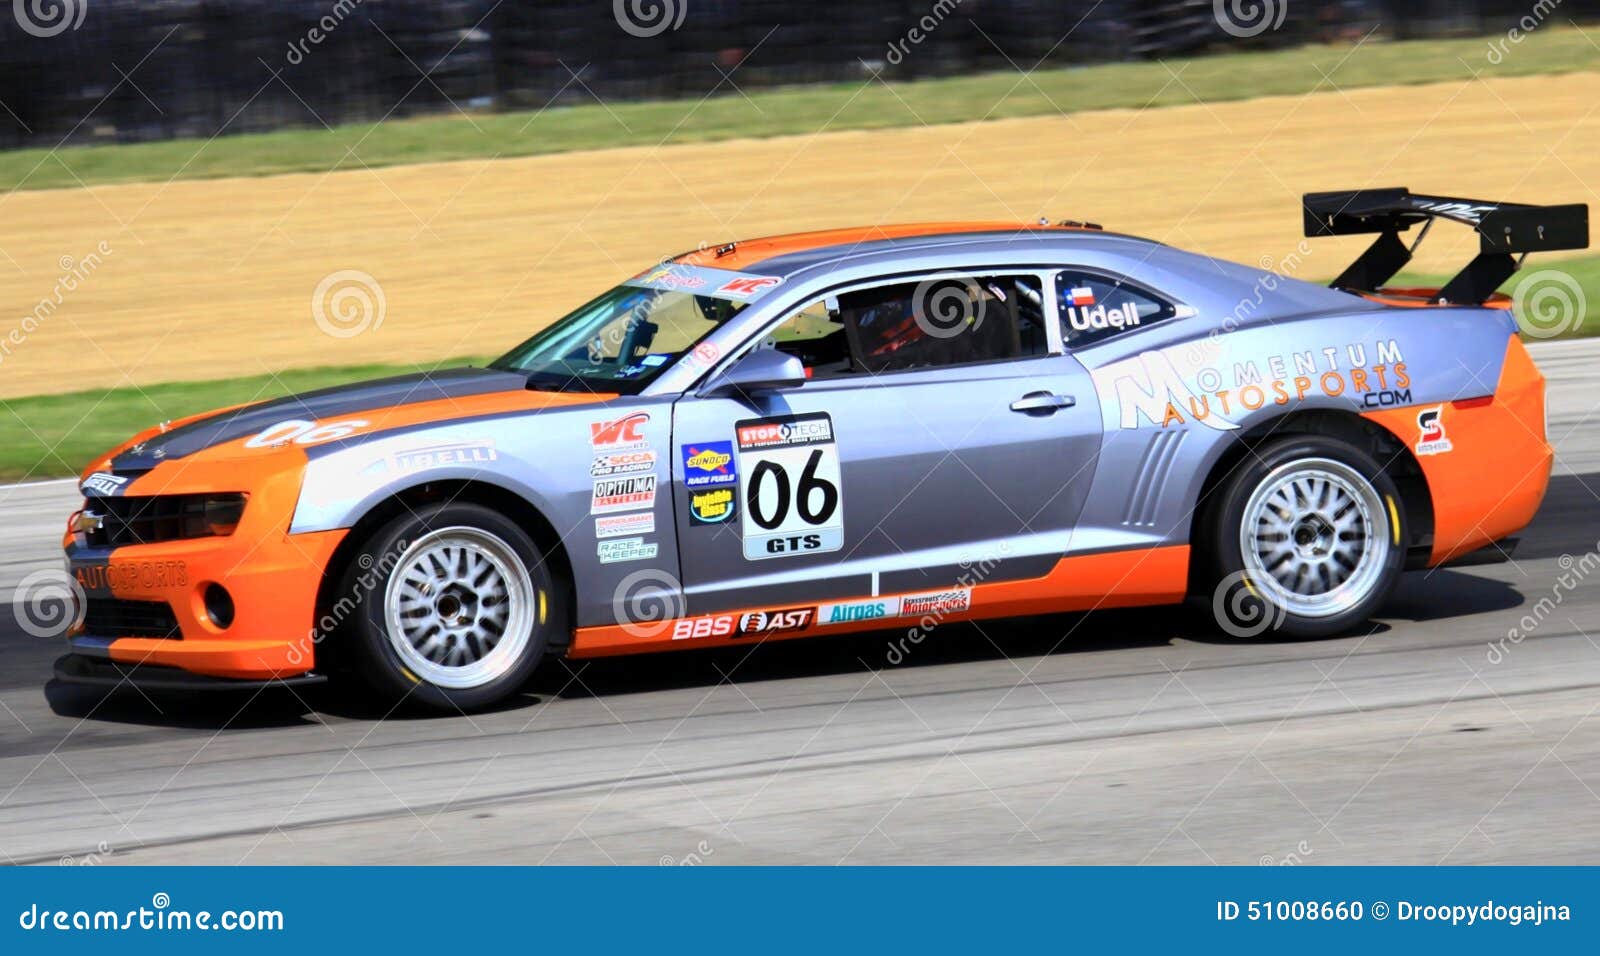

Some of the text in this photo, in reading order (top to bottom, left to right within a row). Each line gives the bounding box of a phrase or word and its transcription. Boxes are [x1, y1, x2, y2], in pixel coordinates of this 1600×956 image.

[1068, 302, 1141, 331] Udell
[1162, 363, 1411, 429] AUTOSPORTS
[1359, 388, 1413, 410] .COM
[243, 419, 371, 448] 06
[688, 454, 729, 467] SUNOCO
[595, 477, 655, 498] OPTIMA
[687, 476, 710, 485] RACE
[747, 448, 839, 531] 06
[603, 547, 656, 560] KEEPER
[766, 534, 821, 554] GTS
[76, 560, 187, 589] AUTOSPORTS
[767, 610, 811, 630] AST
[829, 602, 886, 623] Airgas
[672, 615, 732, 640] BBS
